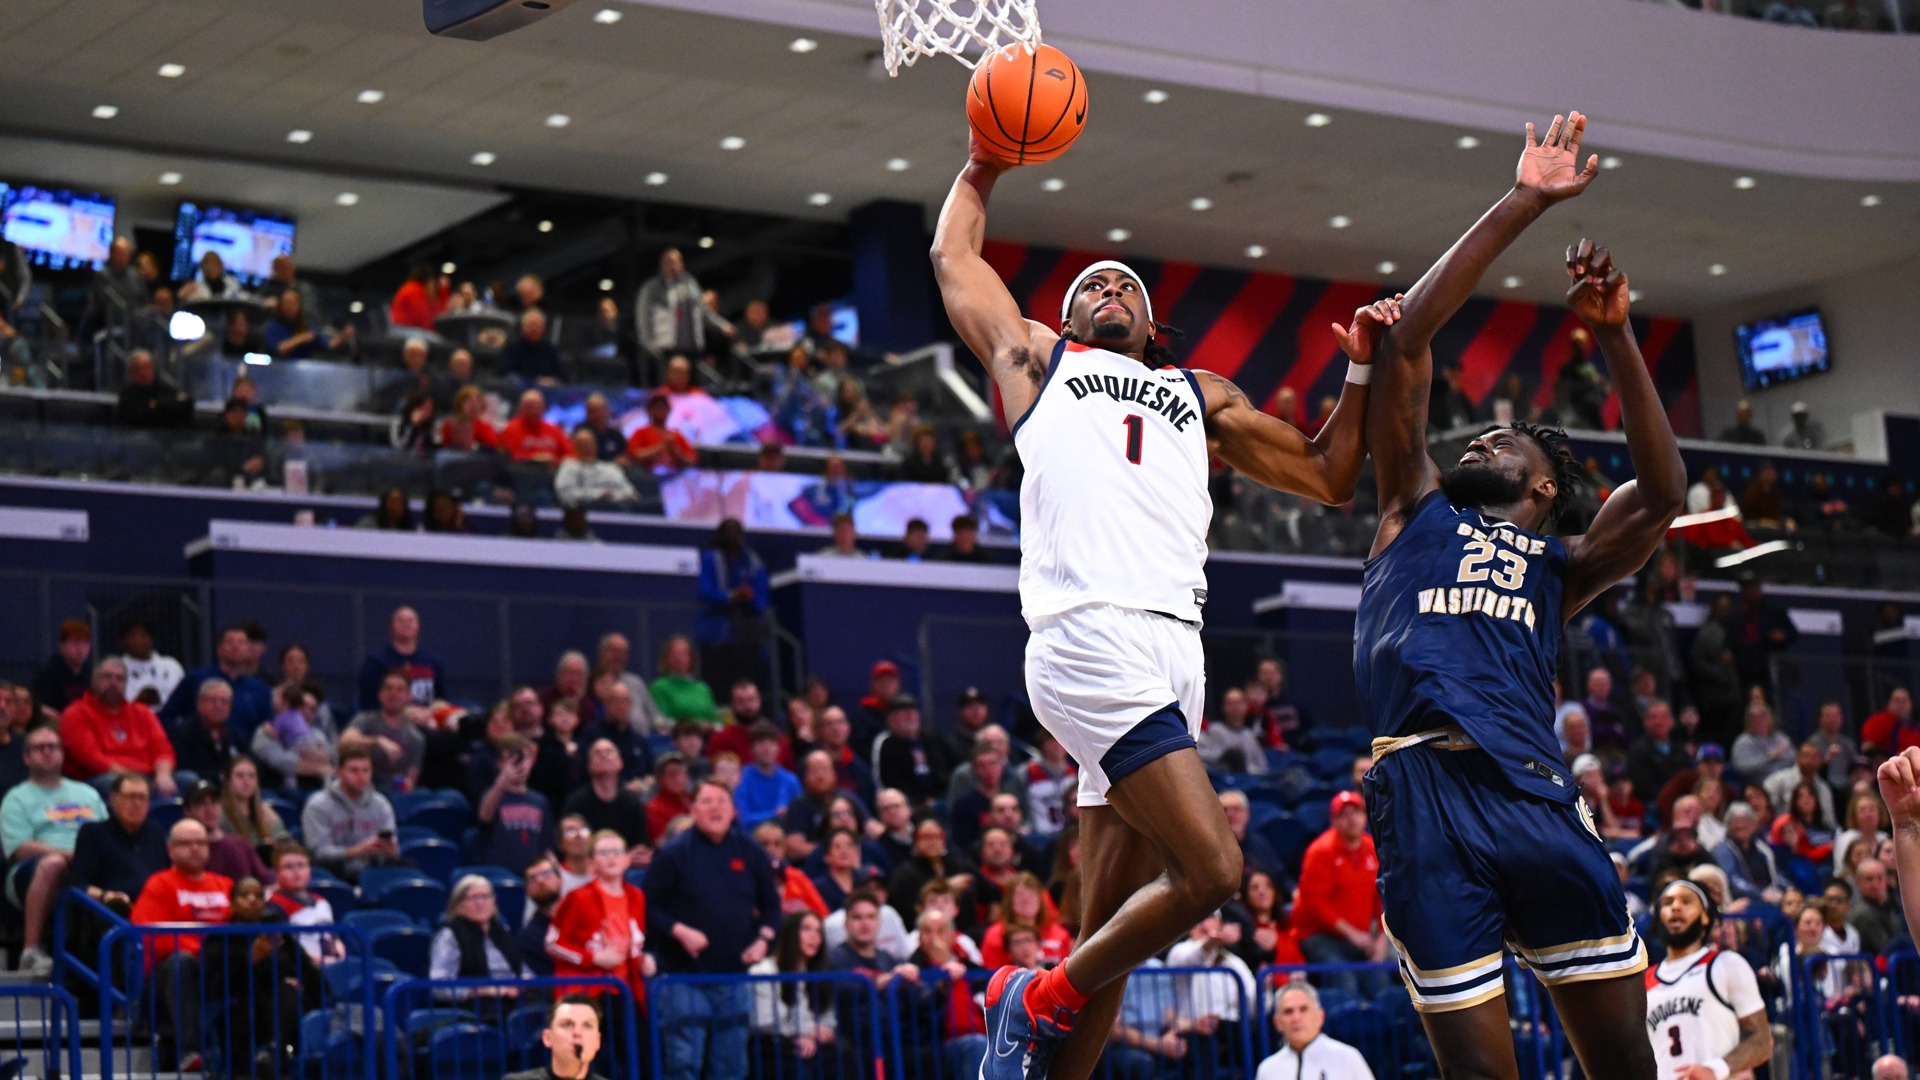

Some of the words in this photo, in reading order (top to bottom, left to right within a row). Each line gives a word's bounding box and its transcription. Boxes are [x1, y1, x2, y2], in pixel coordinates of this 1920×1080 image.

[1064, 374, 1198, 433] DUQUESNE
[1122, 413, 1144, 465] 1
[1456, 540, 1528, 591] 23
[1668, 1024, 1683, 1057] 3
